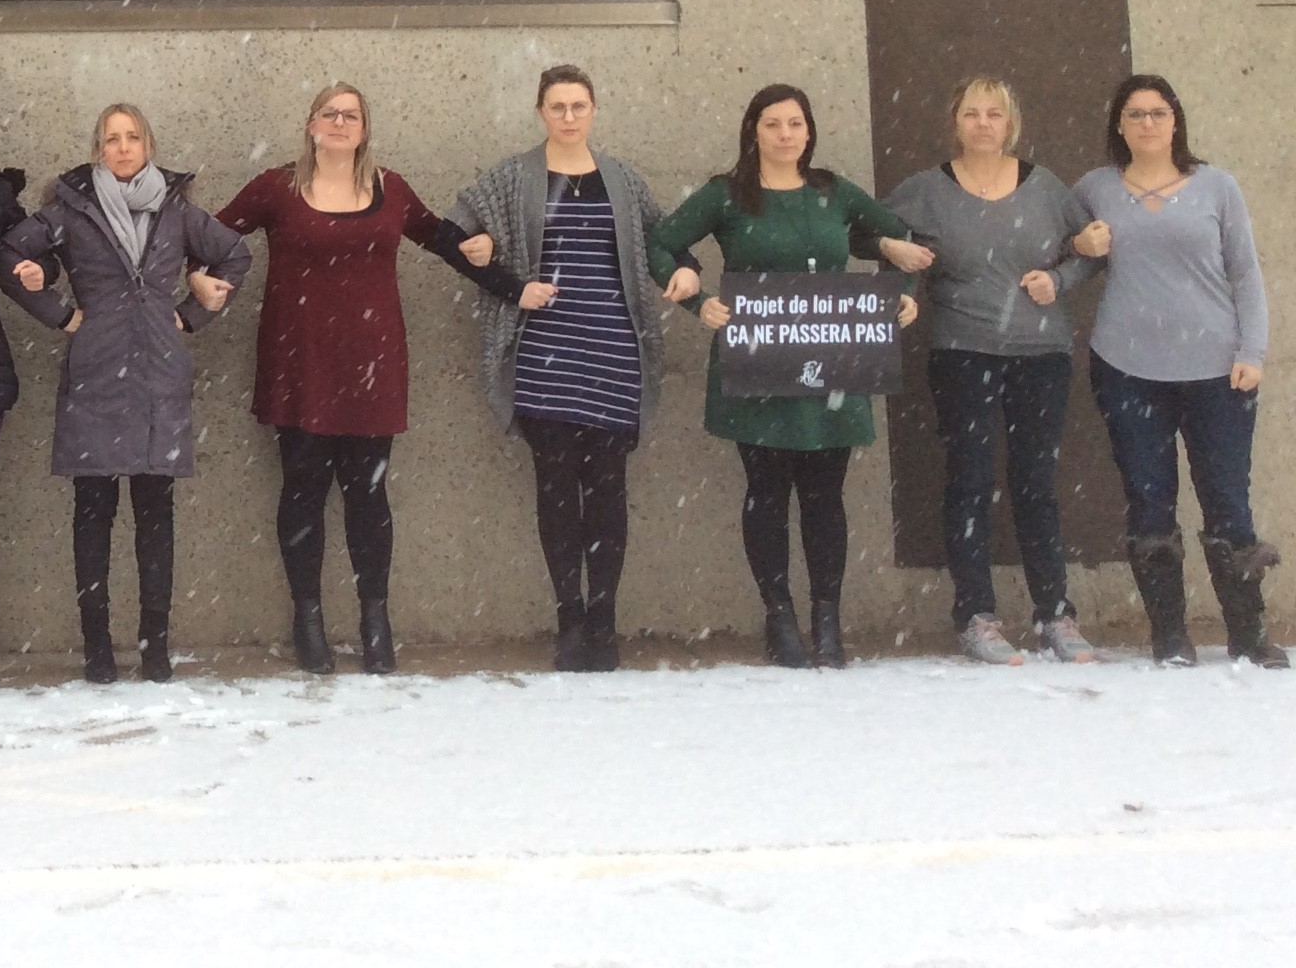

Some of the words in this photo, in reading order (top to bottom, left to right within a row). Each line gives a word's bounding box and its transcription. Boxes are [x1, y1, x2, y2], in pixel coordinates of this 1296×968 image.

[735, 295, 784, 318] Projet
[789, 295, 808, 314] de
[813, 295, 833, 314] loi
[726, 324, 749, 348] ÇA
[754, 324, 774, 344] NE
[779, 323, 851, 344] PASSERA
[855, 322, 893, 344] PAS!
